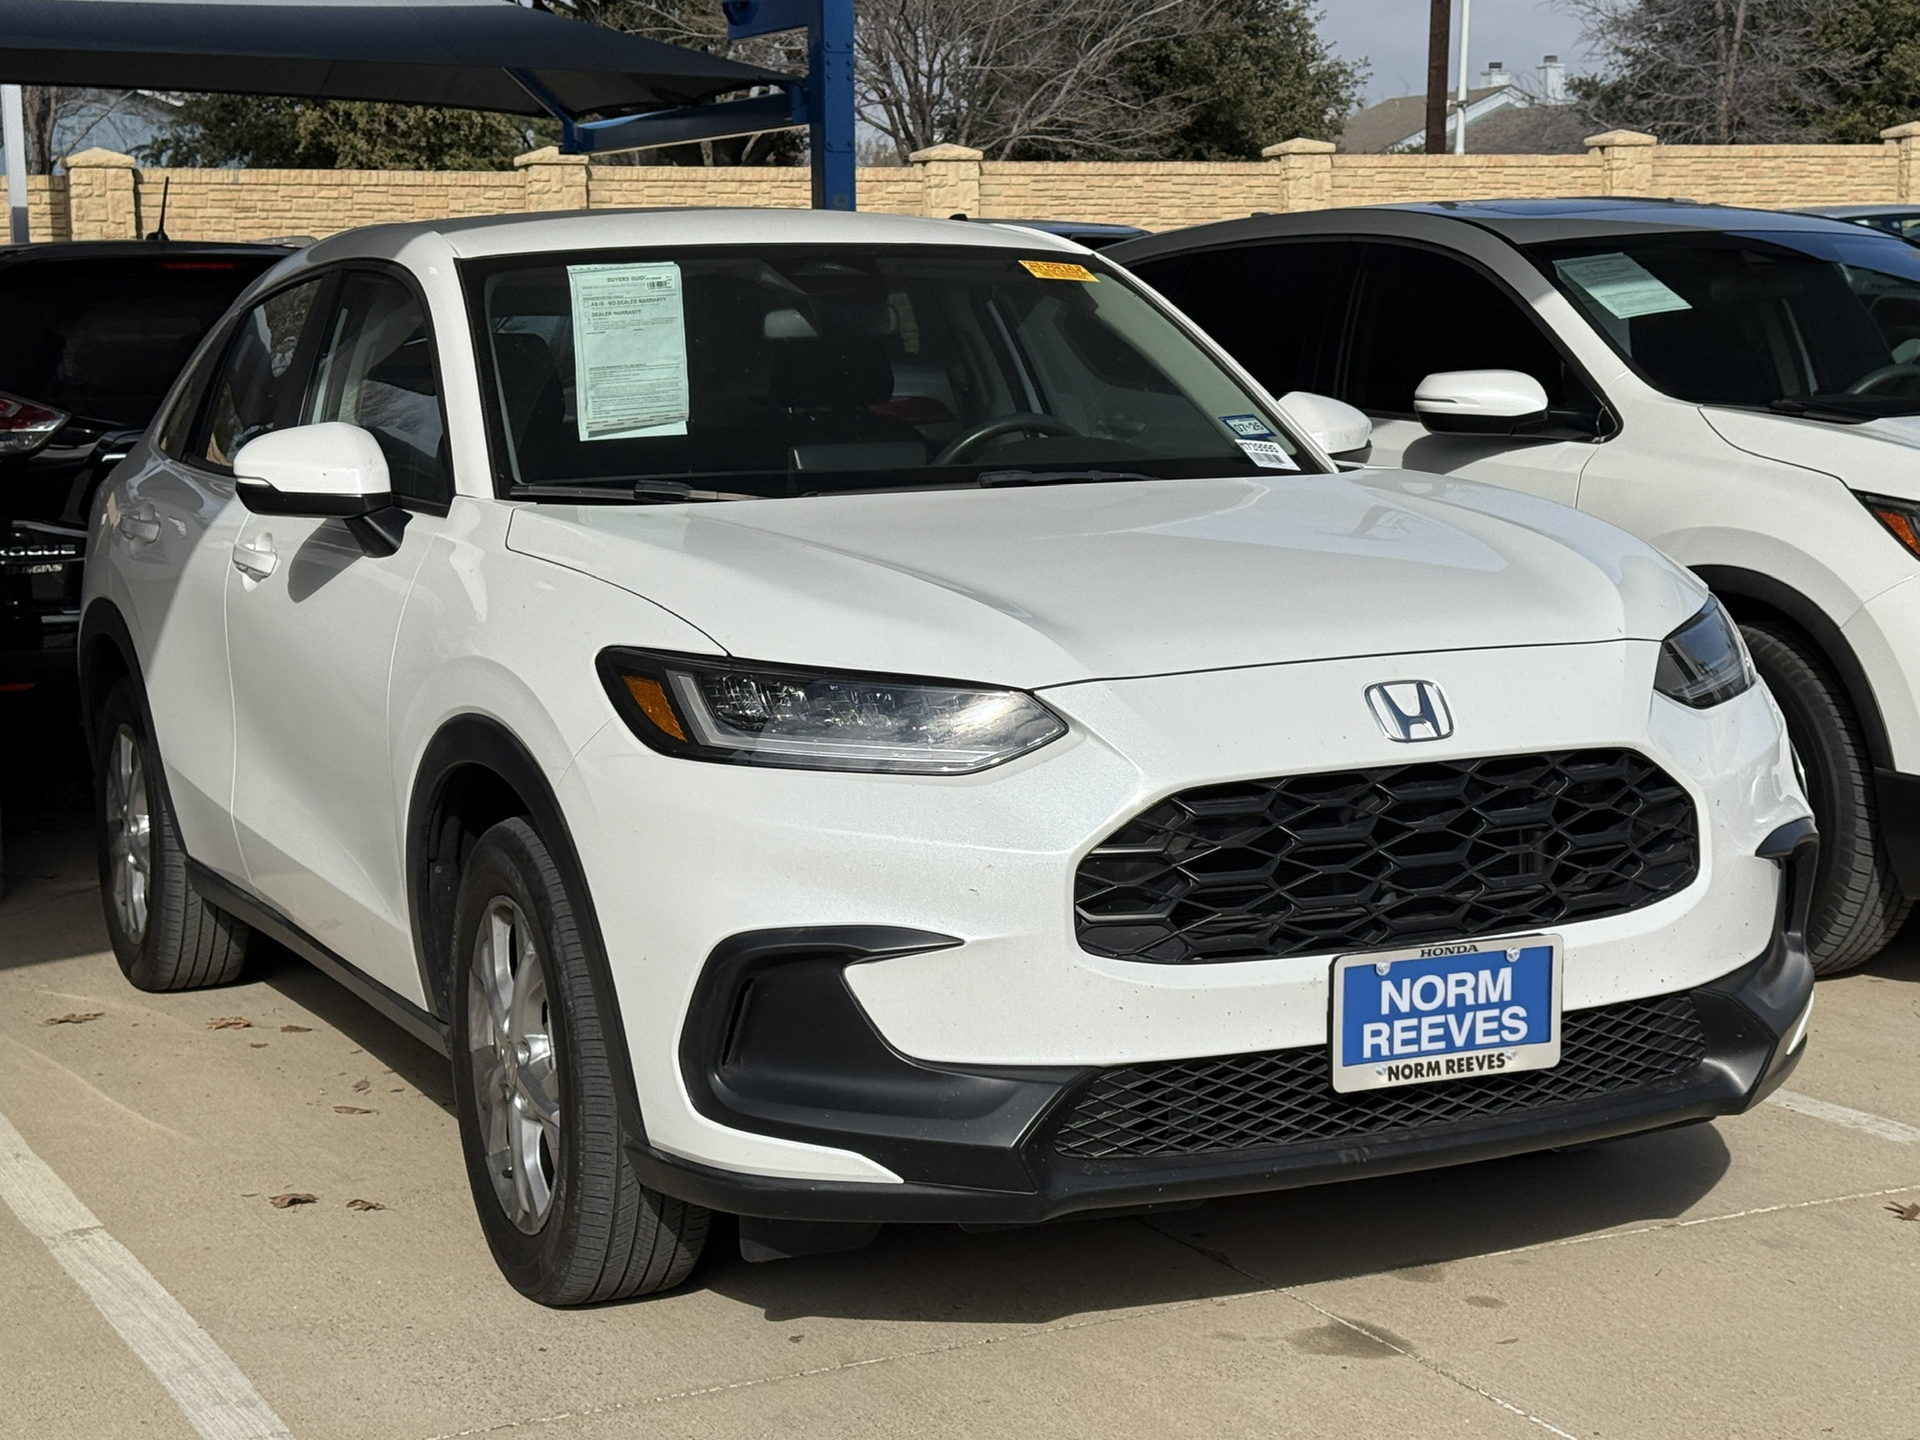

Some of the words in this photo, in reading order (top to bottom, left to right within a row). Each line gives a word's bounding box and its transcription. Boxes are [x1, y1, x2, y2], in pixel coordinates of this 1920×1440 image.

[1420, 944, 1479, 958] HONDA
[1381, 967, 1513, 1016] NORM
[1362, 1005, 1528, 1059] REEVES
[1387, 1060, 1442, 1082] NORM
[1445, 1052, 1506, 1075] REEVES
